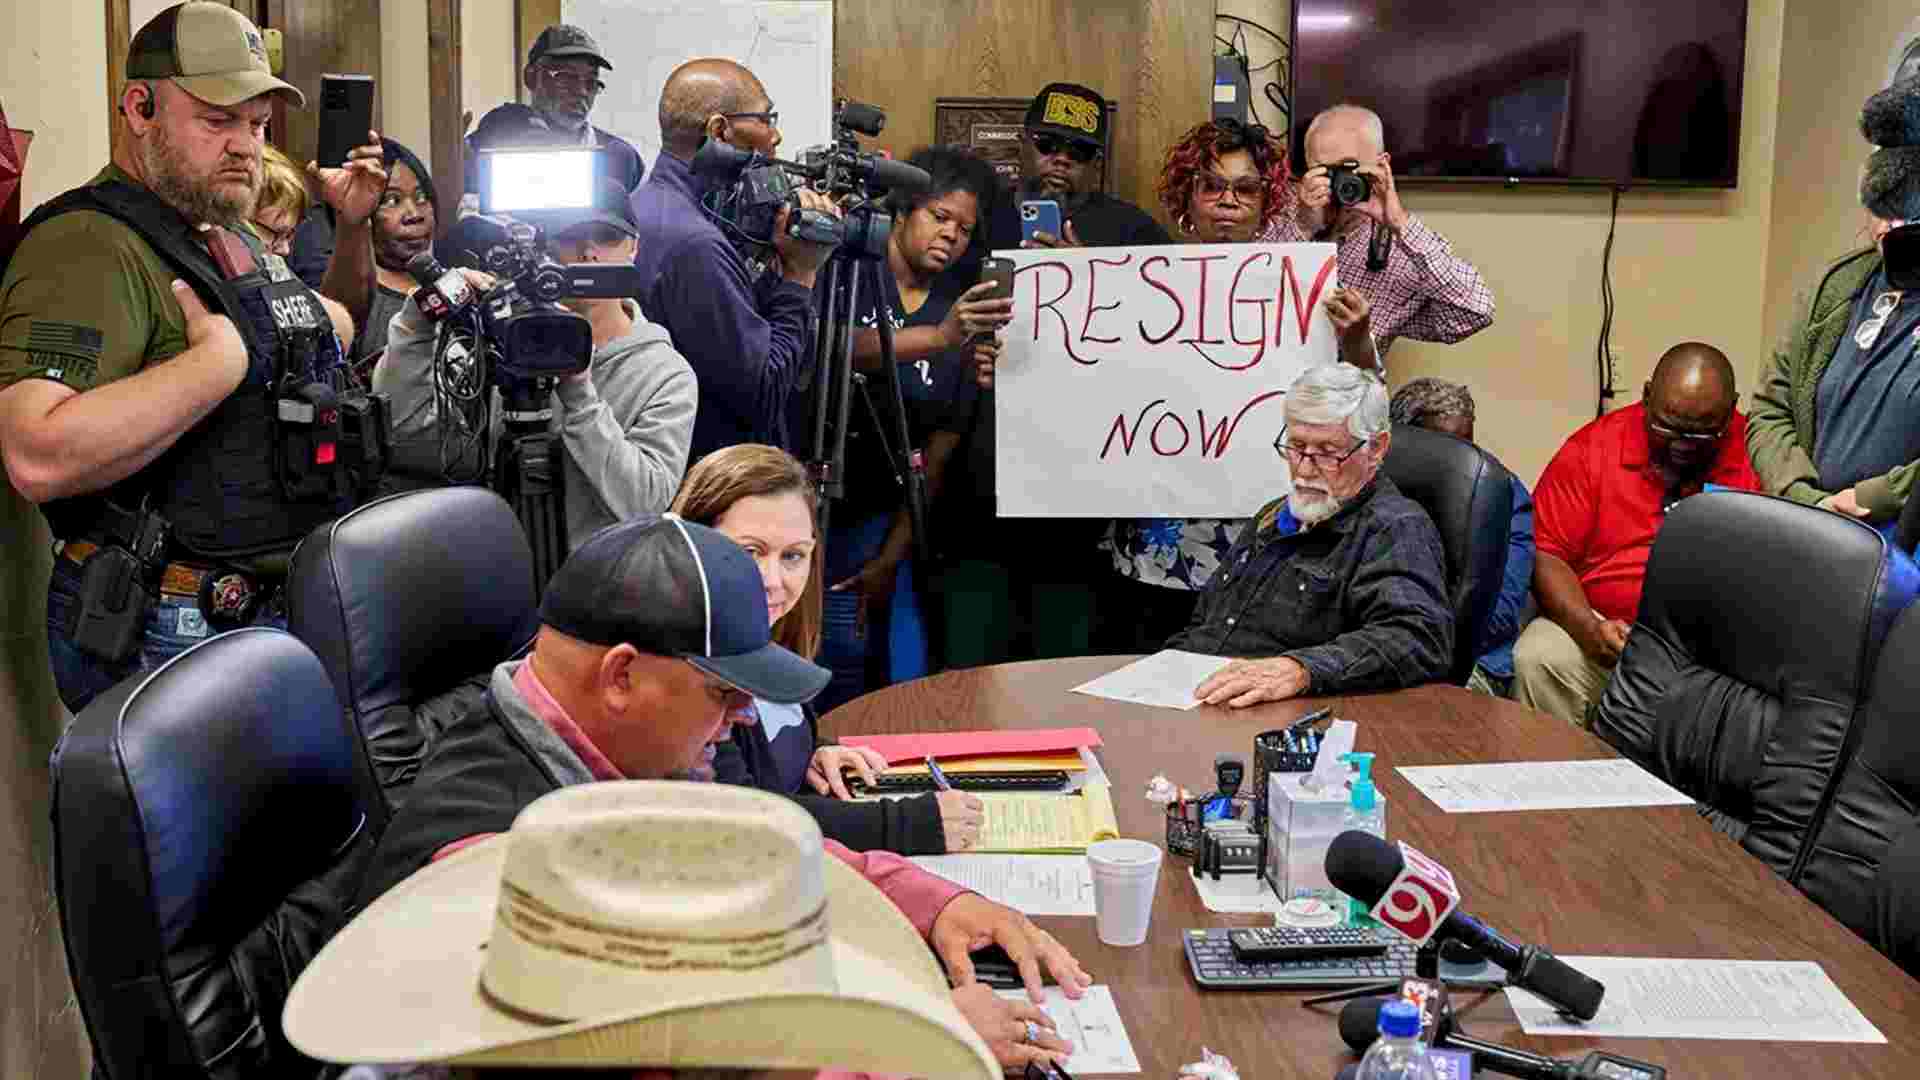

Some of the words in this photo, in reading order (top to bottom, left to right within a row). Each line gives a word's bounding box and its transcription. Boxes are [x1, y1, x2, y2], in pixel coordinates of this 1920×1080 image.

[1014, 252, 1336, 370] RESIGN
[1100, 390, 1286, 459] NOW
[1385, 880, 1439, 938] 9
